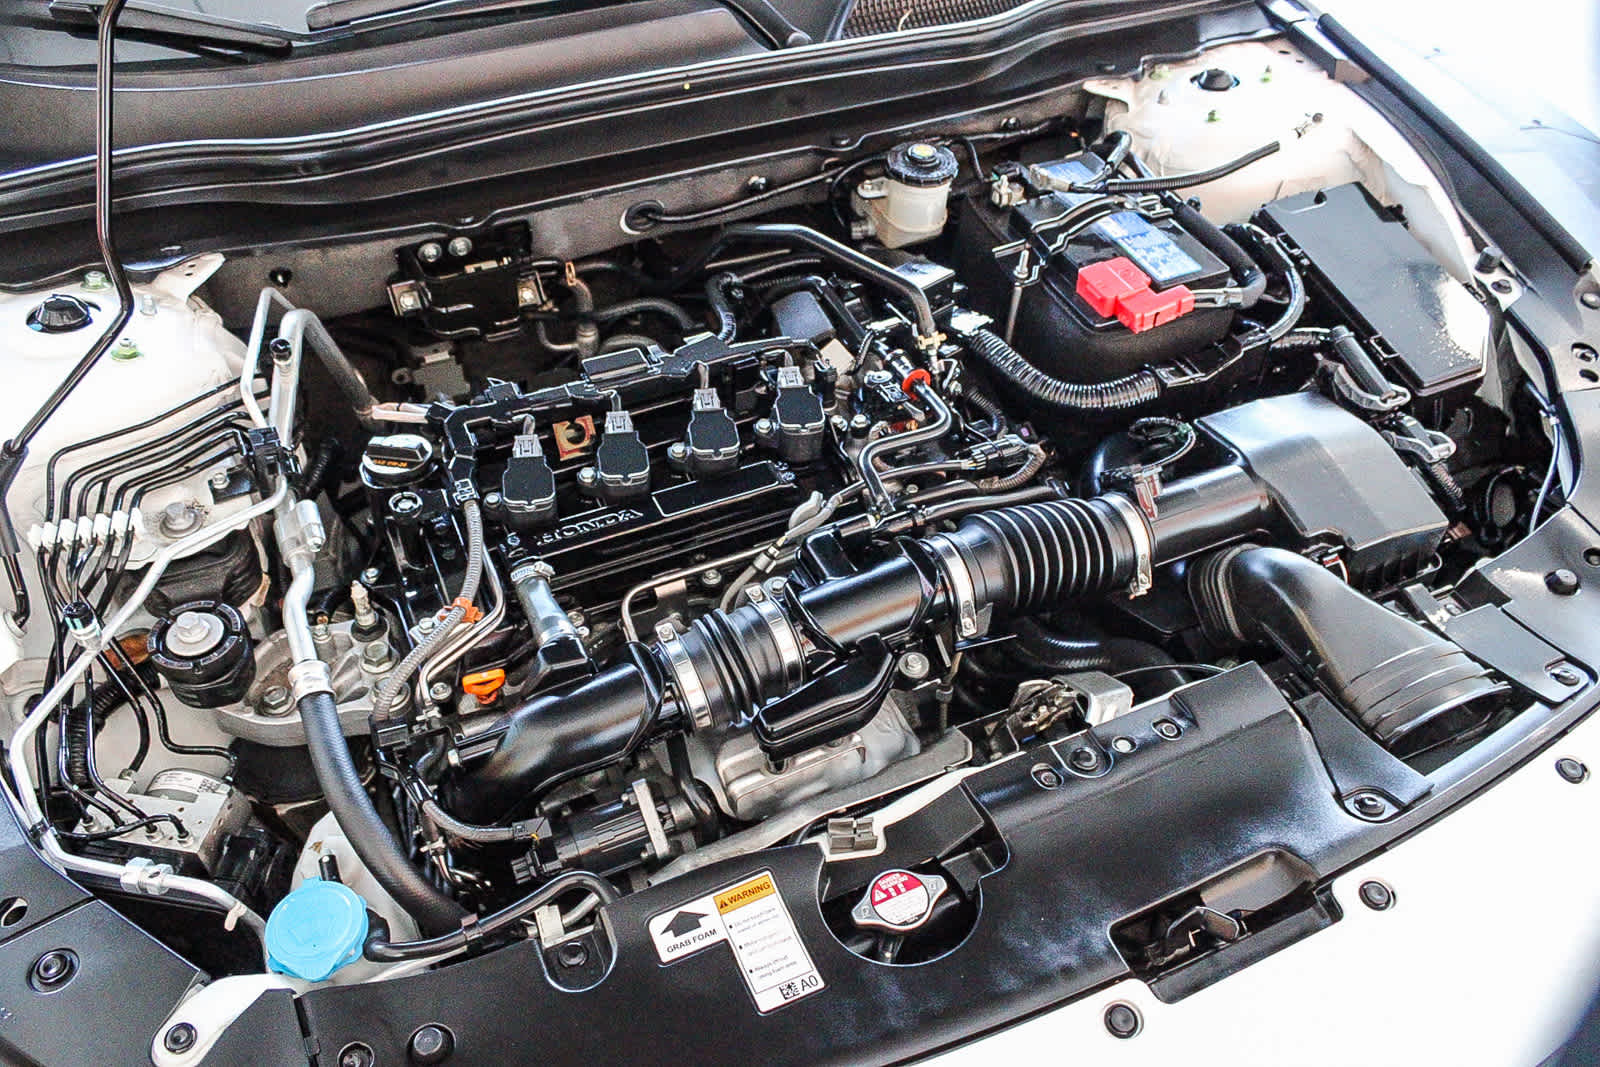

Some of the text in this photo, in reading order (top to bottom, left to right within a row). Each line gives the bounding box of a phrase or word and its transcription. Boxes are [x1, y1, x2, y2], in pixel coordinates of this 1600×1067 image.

[727, 880, 771, 905] WARNING
[666, 928, 718, 953] GRAB FOAM
[801, 974, 819, 992] A0
